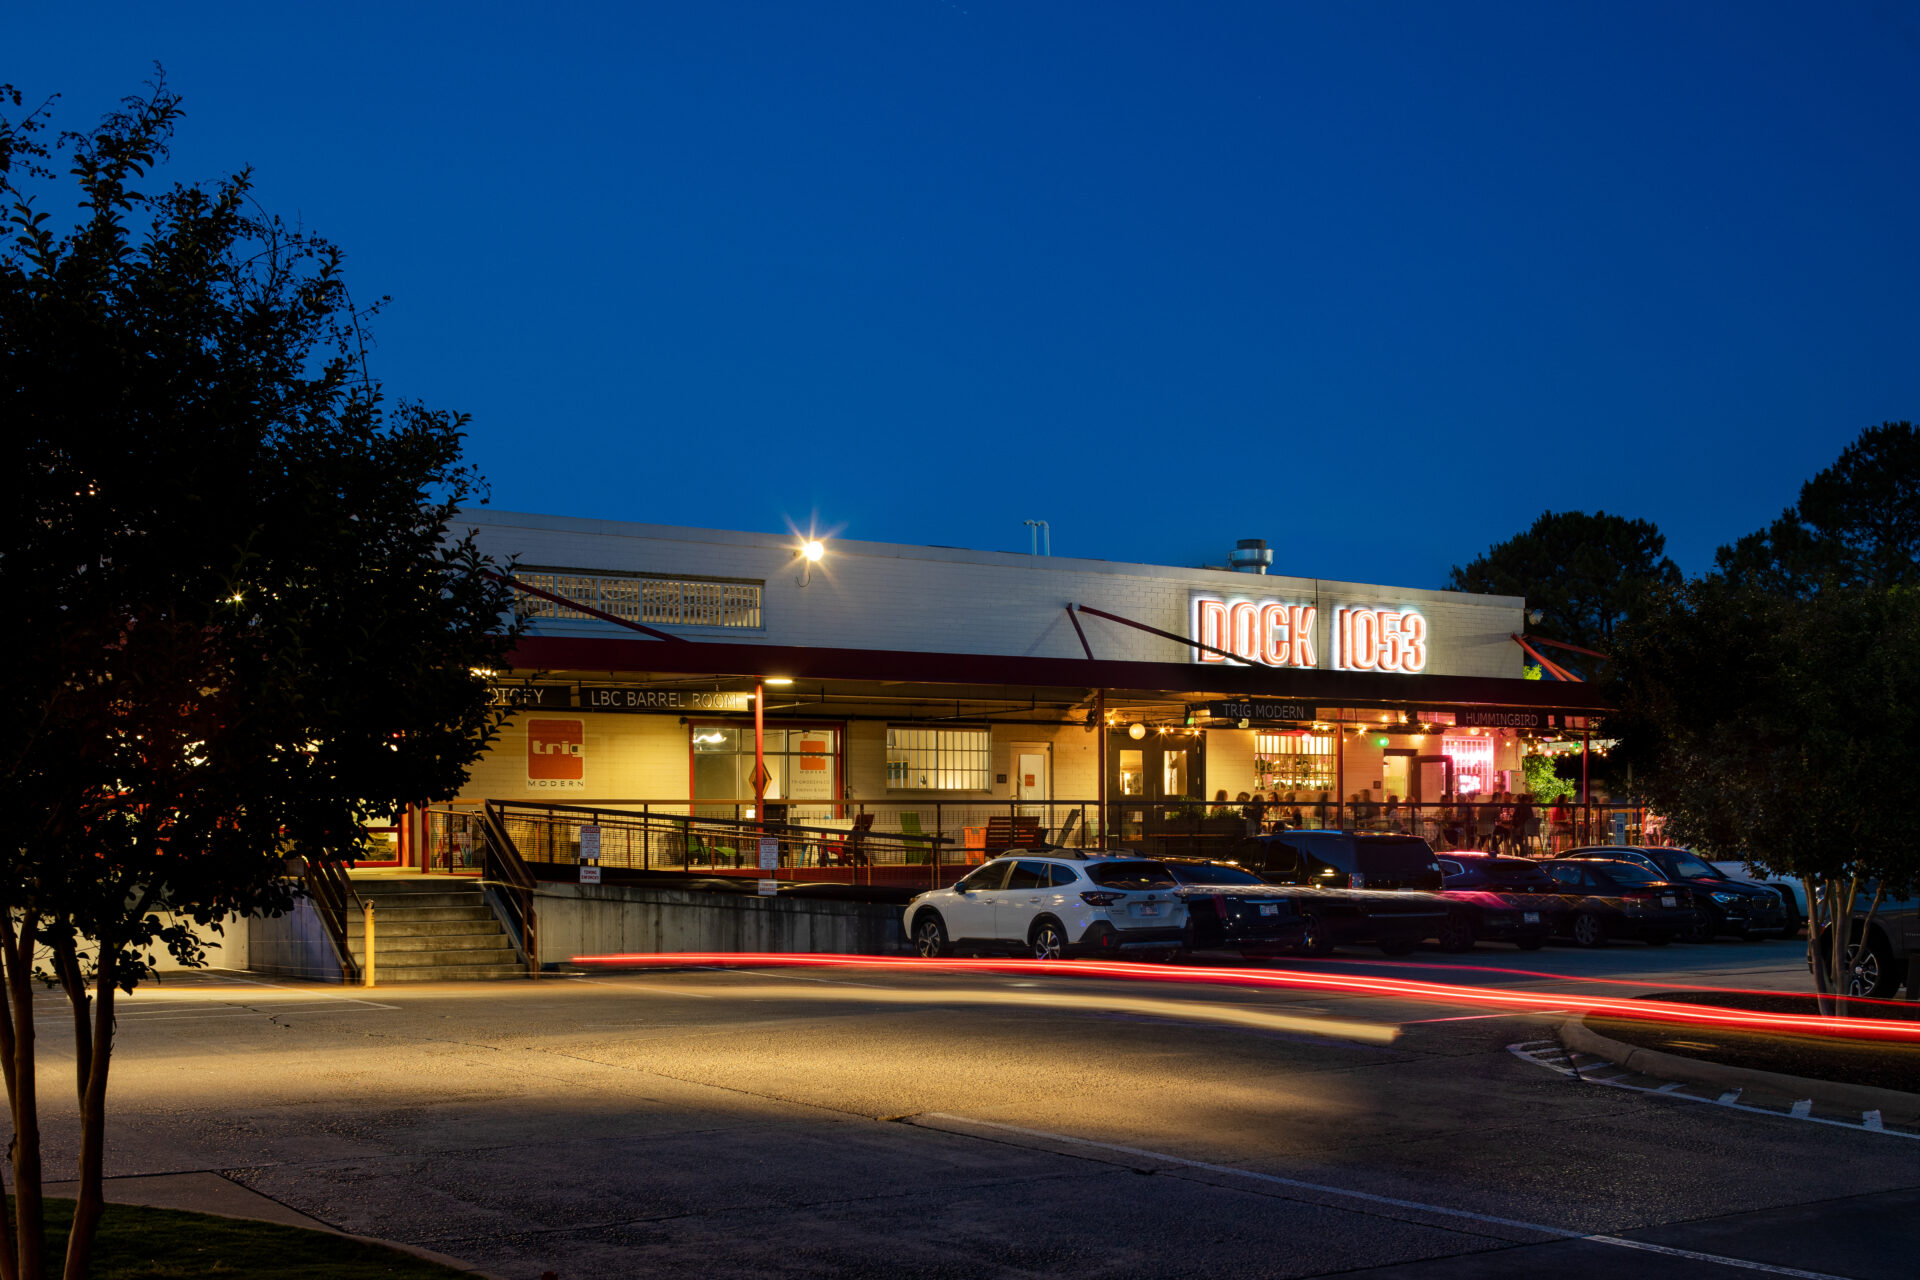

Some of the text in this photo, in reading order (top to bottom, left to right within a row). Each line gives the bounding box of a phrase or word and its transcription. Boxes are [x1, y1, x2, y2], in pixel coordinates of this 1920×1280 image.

[1198, 600, 1427, 673] DOCK 1053
[591, 690, 737, 709] LBC BARREL ROOM
[1222, 703, 1305, 719] TRIG MODERN
[1465, 711, 1539, 727] HUMMINGBIRD
[532, 740, 585, 758] trig
